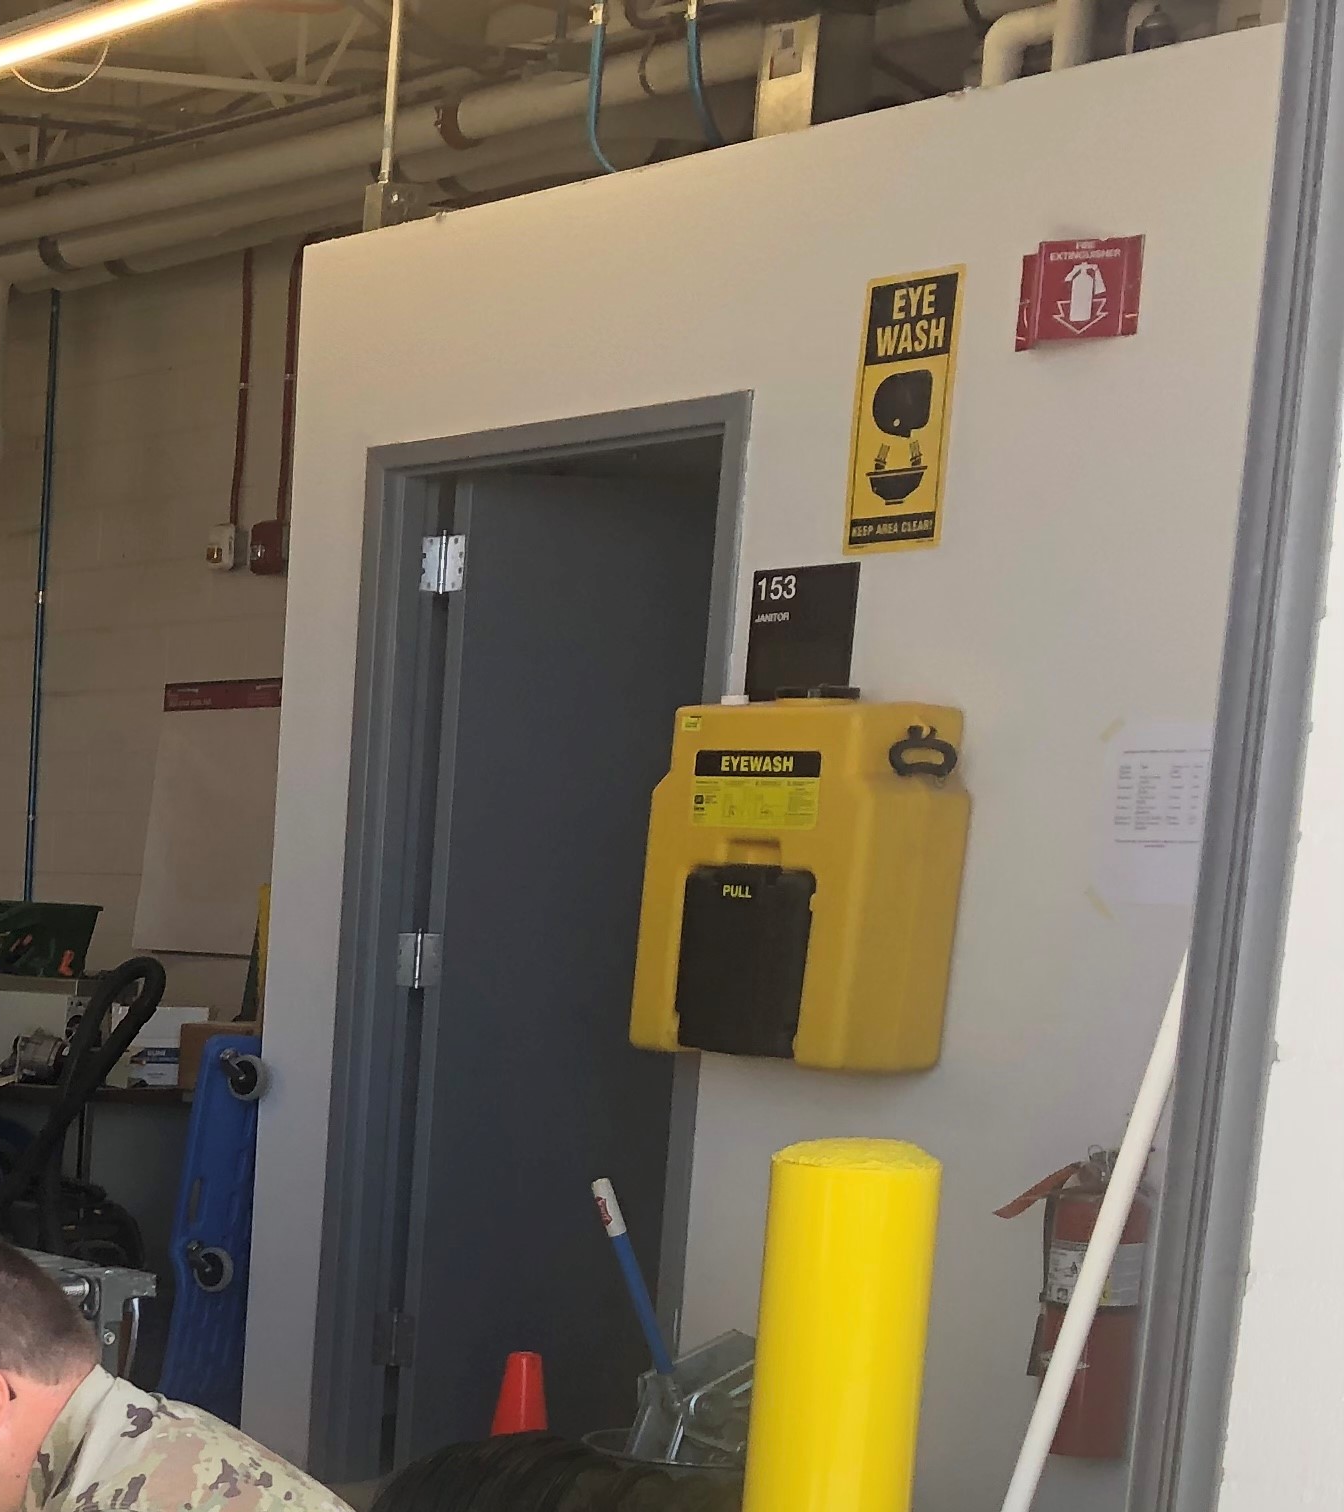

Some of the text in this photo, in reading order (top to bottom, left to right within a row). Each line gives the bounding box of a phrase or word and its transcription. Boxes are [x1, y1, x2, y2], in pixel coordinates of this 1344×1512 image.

[1049, 247, 1122, 262] EXTINGUISHER
[892, 283, 938, 321] EYE
[876, 316, 946, 358] WASH
[851, 519, 933, 538] KEEP AREA CLEAR!
[757, 575, 797, 601] 153
[754, 611, 790, 623] JANITOR
[720, 755, 794, 772] EYEWASH
[722, 884, 752, 899] PULL
